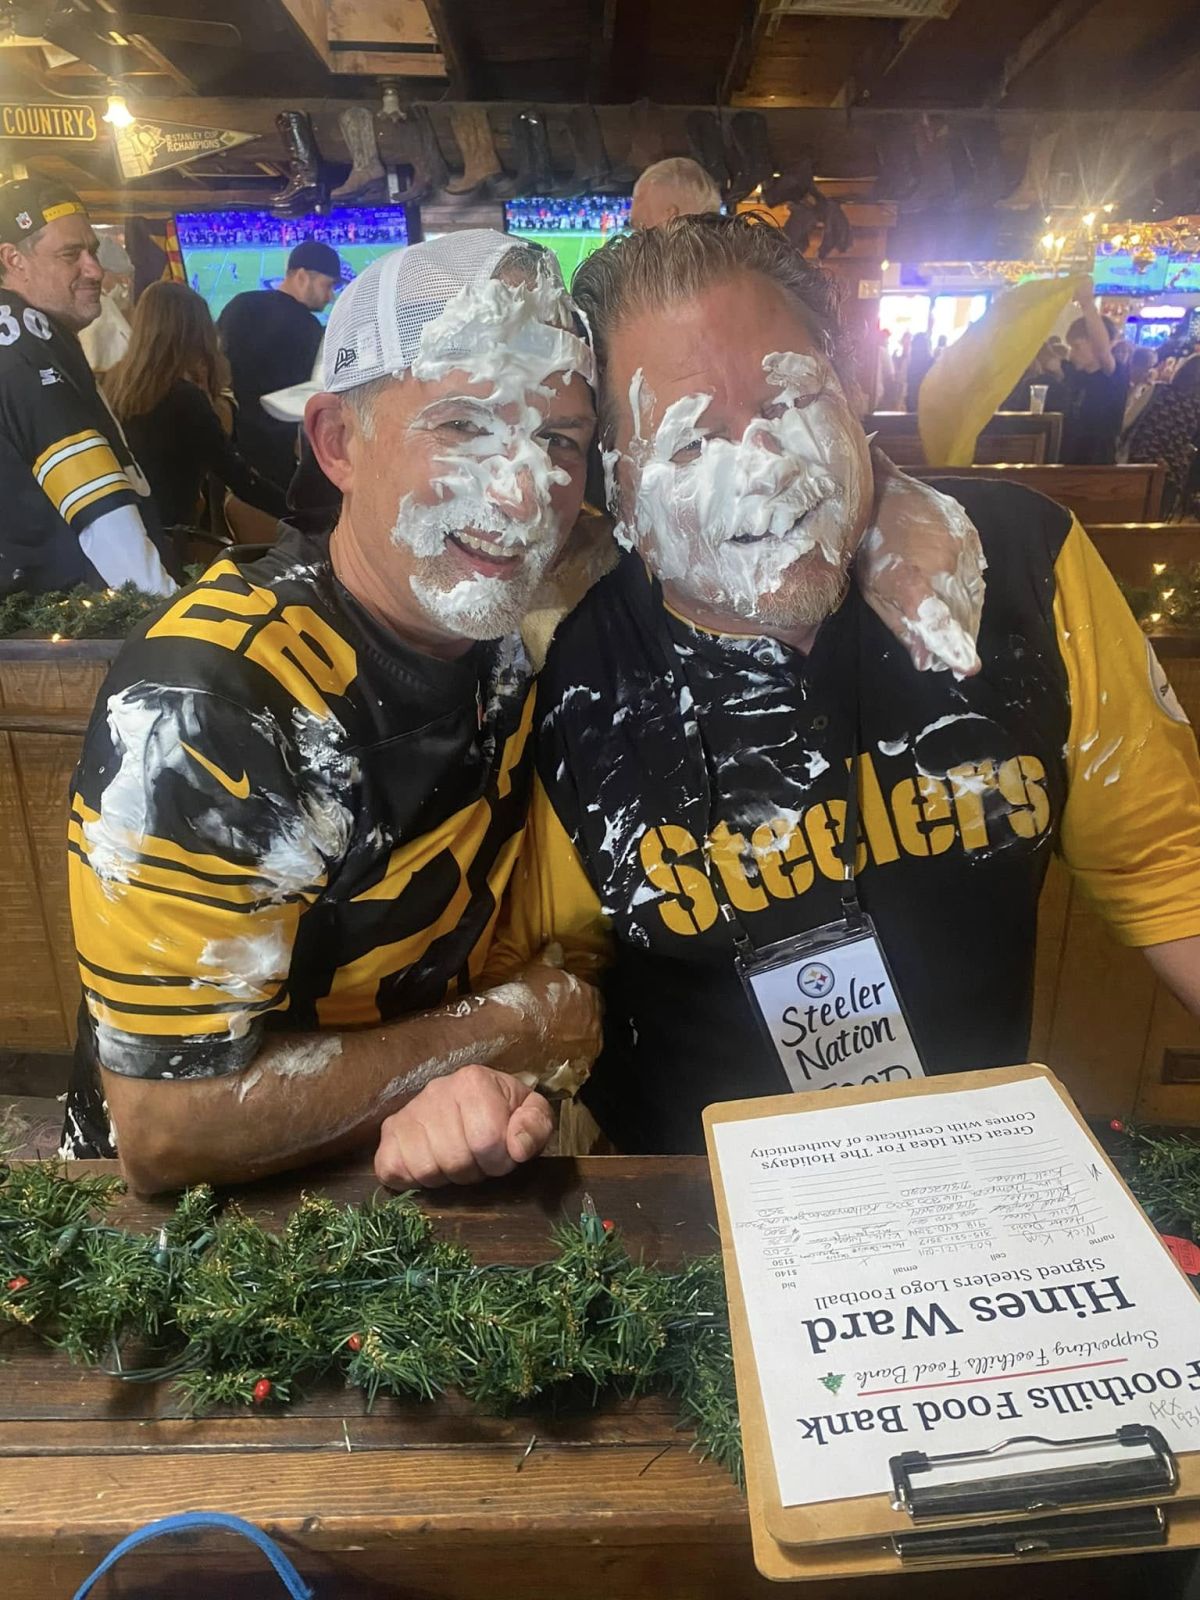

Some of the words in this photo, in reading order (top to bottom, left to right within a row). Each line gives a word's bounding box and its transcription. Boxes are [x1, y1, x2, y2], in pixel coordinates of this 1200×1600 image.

[3, 108, 86, 136] COUNTRY
[172, 131, 202, 142] STANLEY
[173, 138, 220, 152] CHAMPIONS
[638, 752, 1051, 936] Steelers
[781, 977, 886, 1048] Steeler
[795, 1016, 897, 1080] Nation
[947, 1121, 982, 1131] with
[985, 1112, 1035, 1125] Comes
[866, 1126, 943, 1141] Certificate
[952, 1134, 982, 1144] Gift
[986, 1126, 1033, 1138] Great
[751, 1140, 841, 1157] Authenticity
[847, 1138, 861, 1147] of
[877, 1144, 905, 1153] For
[910, 1138, 946, 1148] Idea
[762, 1153, 835, 1169] Holidays
[841, 1149, 872, 1159] The
[1087, 1234, 1115, 1244] name
[772, 1256, 794, 1266] $150
[990, 1253, 1006, 1261] cell
[893, 1265, 917, 1274] email
[1037, 1258, 1105, 1279] Signed
[953, 1269, 1032, 1287] Steelers
[901, 1280, 948, 1294] Logo
[816, 1288, 895, 1310] Football
[970, 1276, 1136, 1321] Hines
[801, 1303, 963, 1354] Ward
[1055, 1331, 1158, 1356] Supporting
[968, 1348, 1049, 1374] Foothills
[857, 1366, 907, 1388] Bank
[915, 1360, 960, 1381] Food
[913, 1392, 1022, 1430] Food
[797, 1405, 908, 1445] Bank
